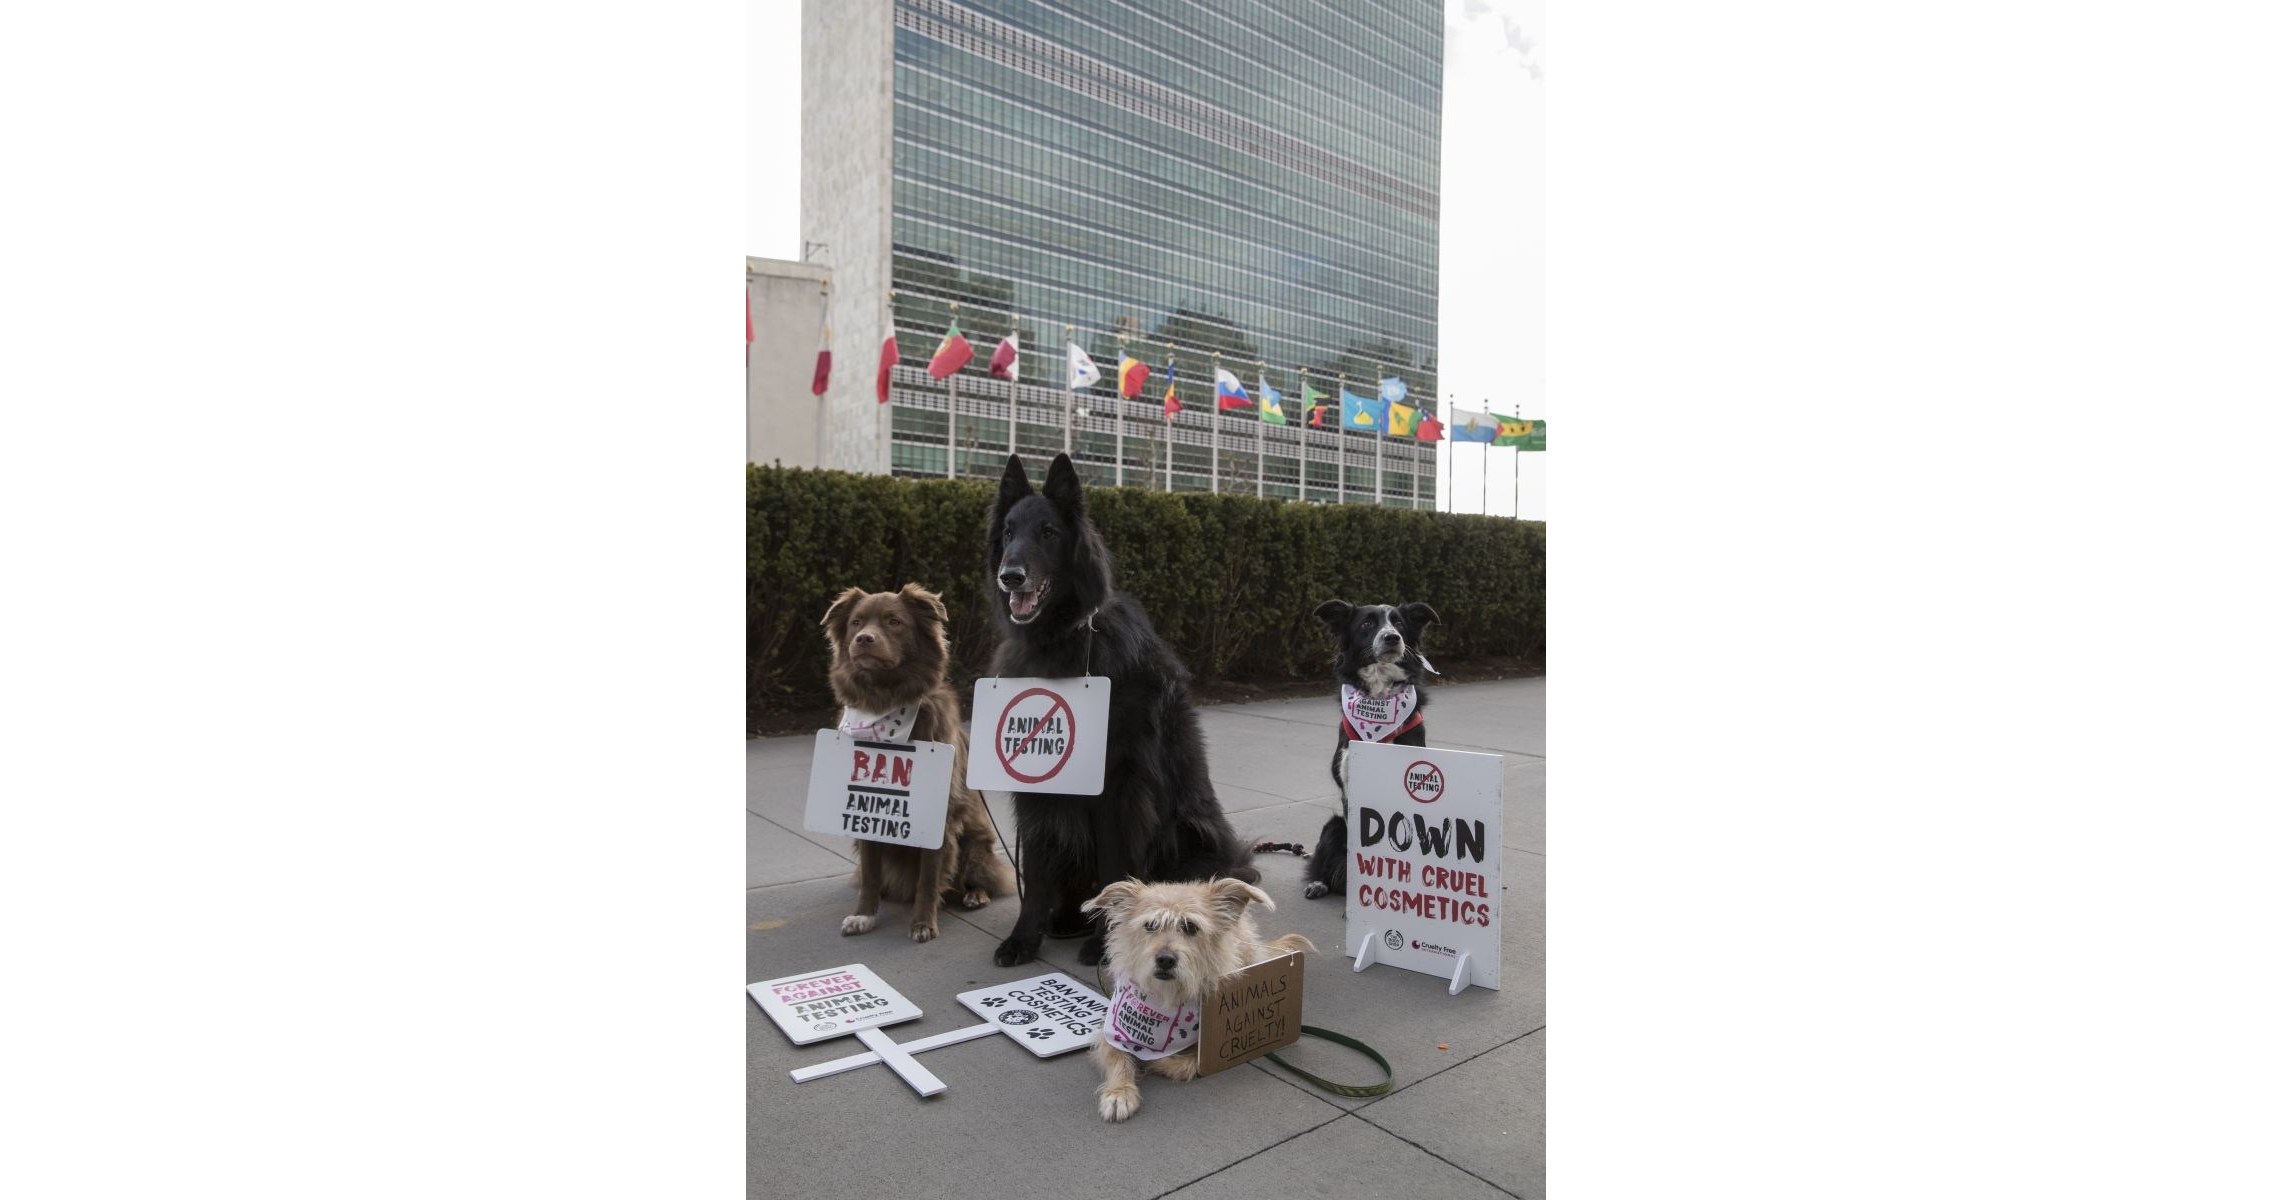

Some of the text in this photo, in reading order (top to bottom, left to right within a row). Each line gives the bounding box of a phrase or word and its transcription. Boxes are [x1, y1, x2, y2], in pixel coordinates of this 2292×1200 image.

[1356, 703, 1385, 713] ANIMAL
[1357, 709, 1388, 720] TESTING
[1007, 717, 1063, 734] ANIMAL
[1004, 737, 1065, 755] TESTING
[851, 750, 914, 787] BAN
[1409, 772, 1439, 783] ANIMAL
[1408, 781, 1440, 793] TESTING
[846, 793, 910, 818] ANIMAL
[842, 813, 911, 839] TESTING
[1360, 807, 1485, 864] DOWN
[1356, 852, 1488, 898] WITH CRUEL
[1359, 884, 1490, 927] COSMETICS
[1421, 942, 1457, 955] Cruelty Free
[771, 974, 856, 995] FOREVER
[780, 981, 862, 1003] AGAINST
[1040, 979, 1109, 1016] BAN ANIM
[1218, 974, 1287, 1015] ANIMALS
[795, 992, 878, 1014] ANIMAL
[796, 998, 889, 1023] TESTING
[1008, 990, 1093, 1036] COSMETICS
[1030, 986, 1093, 1018] TESTING
[1121, 1001, 1162, 1027] AGAINST
[1118, 1010, 1154, 1036] ANIMAL
[1225, 997, 1286, 1036] AGAINST
[1219, 1016, 1286, 1059] CRUELTY!
